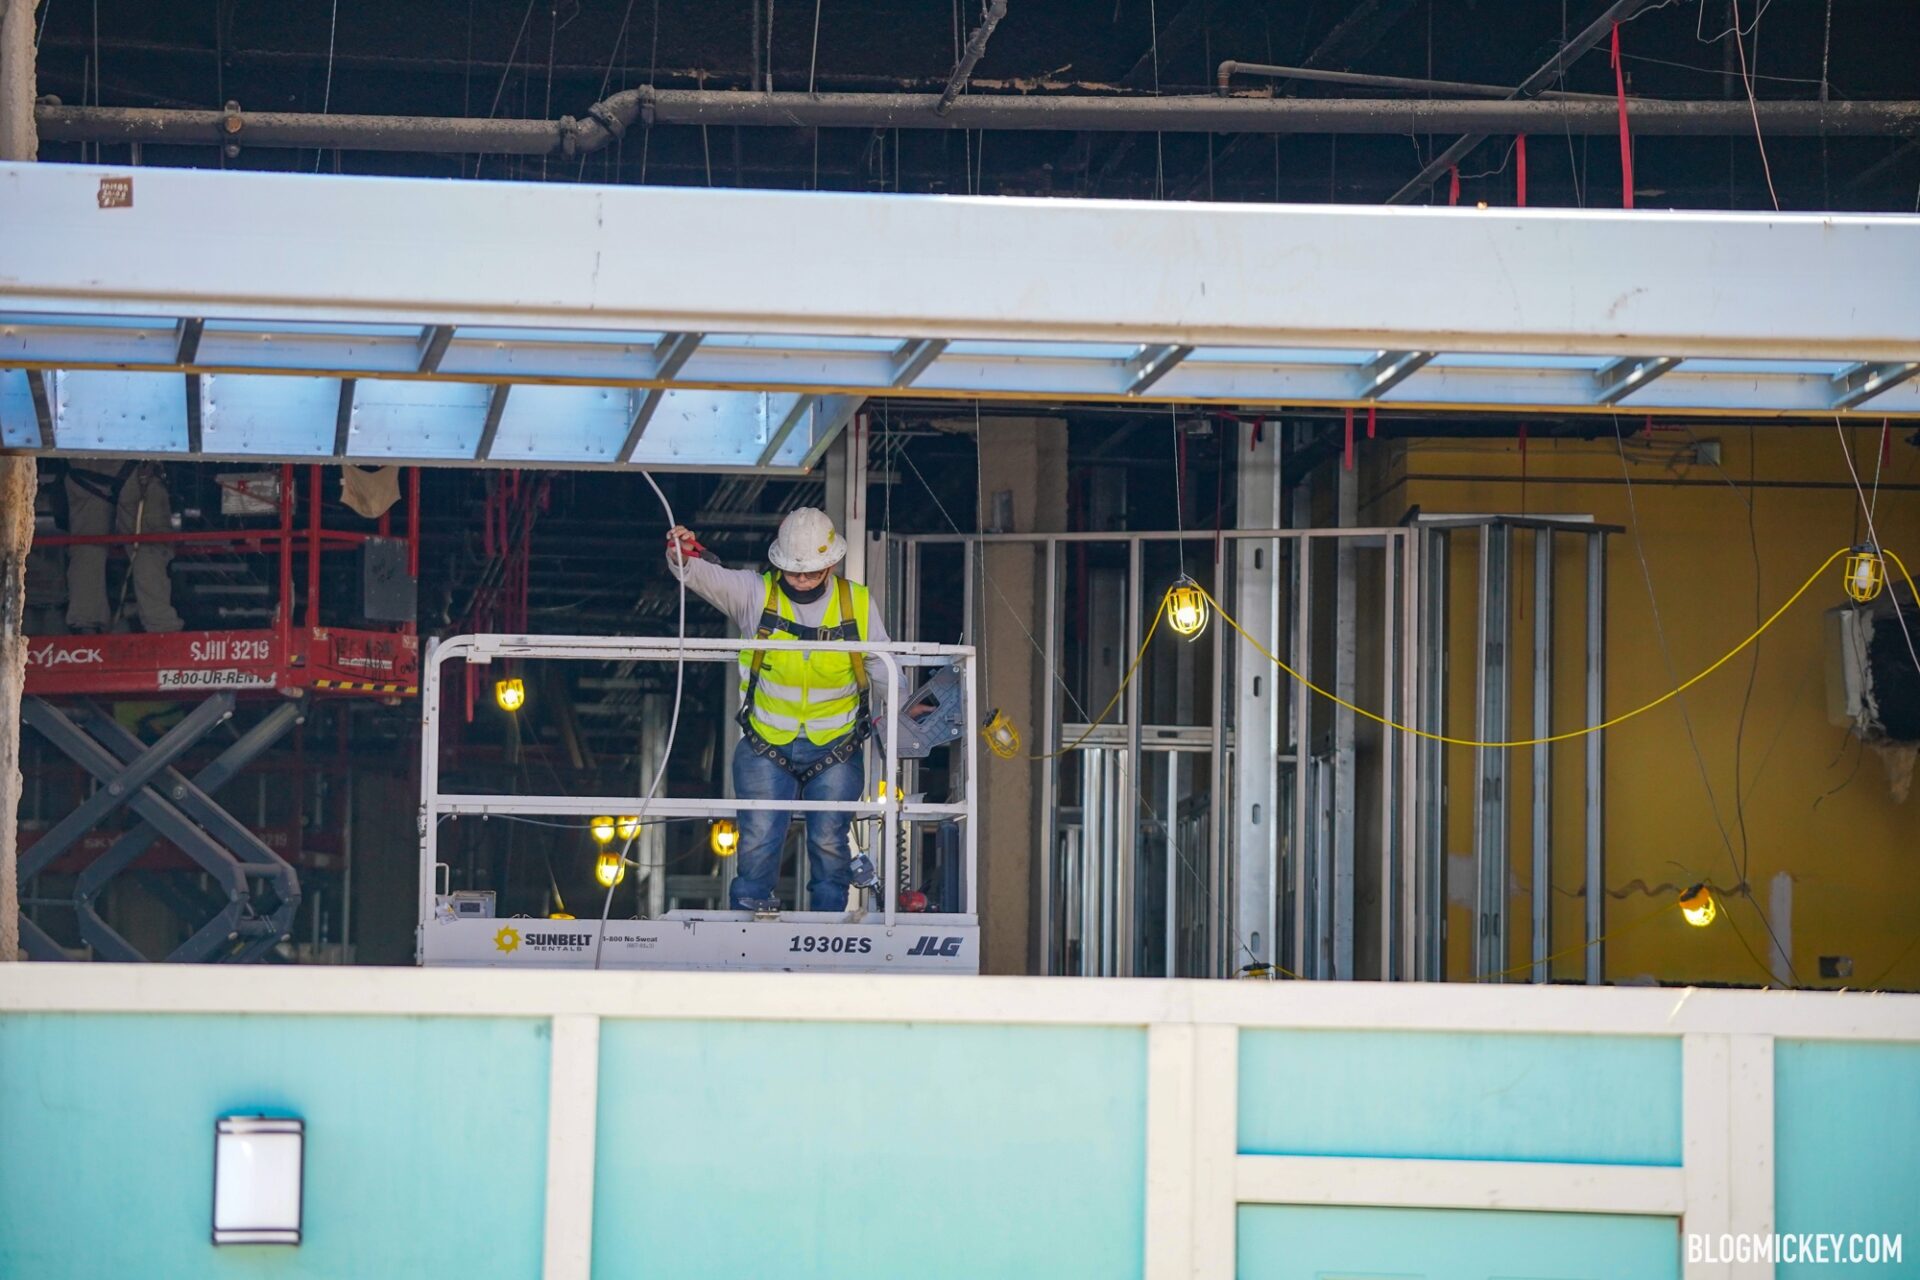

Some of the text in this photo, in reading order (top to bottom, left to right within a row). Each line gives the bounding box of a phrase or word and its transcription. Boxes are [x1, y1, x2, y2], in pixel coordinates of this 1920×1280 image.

[27, 643, 103, 667] YJACK
[231, 640, 269, 660] 3219
[525, 933, 593, 946] SUNBELT
[789, 936, 872, 953] 1930ES
[906, 936, 963, 957] JLG
